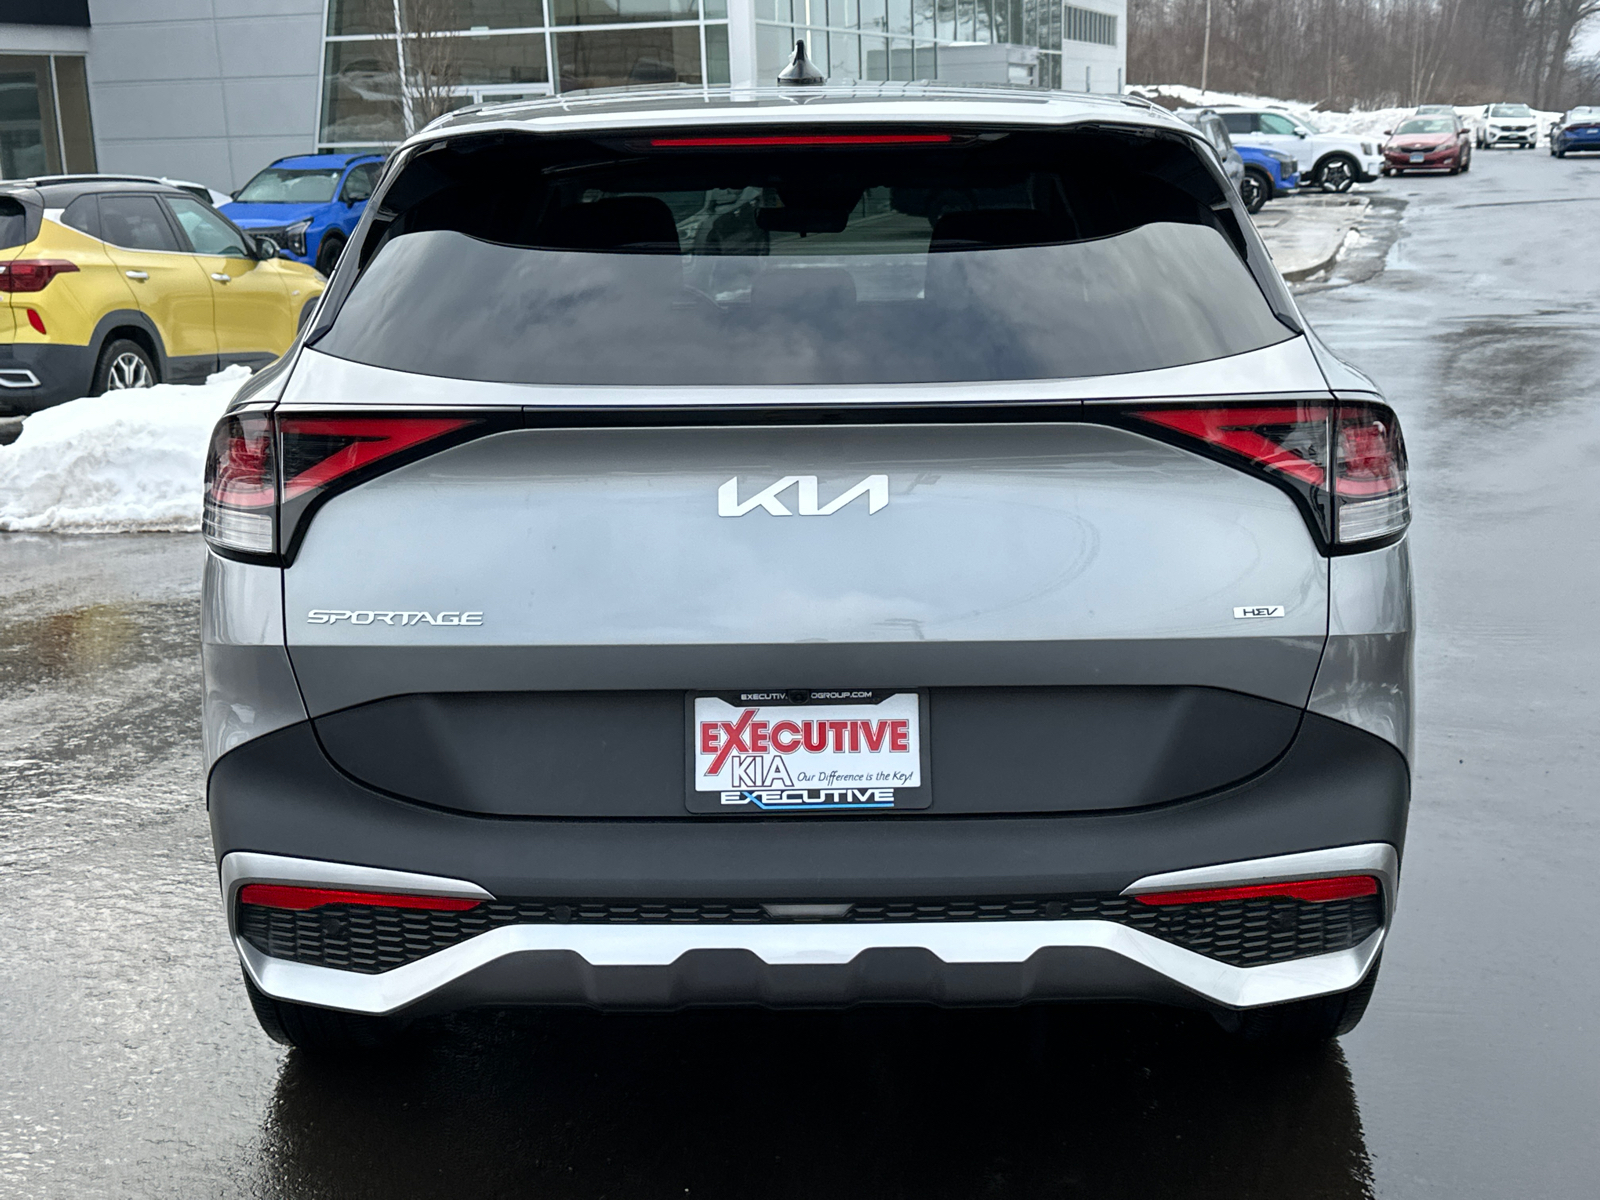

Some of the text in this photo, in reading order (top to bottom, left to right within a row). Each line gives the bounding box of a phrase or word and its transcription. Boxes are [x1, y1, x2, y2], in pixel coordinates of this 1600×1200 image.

[718, 474, 889, 517] KIA
[307, 609, 484, 626] SPORTAGE
[1243, 607, 1278, 616] HEV
[701, 708, 910, 776] EXECUTIVE
[732, 755, 794, 787] KIA
[797, 770, 913, 786] Our Difference is the Key!
[721, 788, 894, 808] EXECUTIVE
